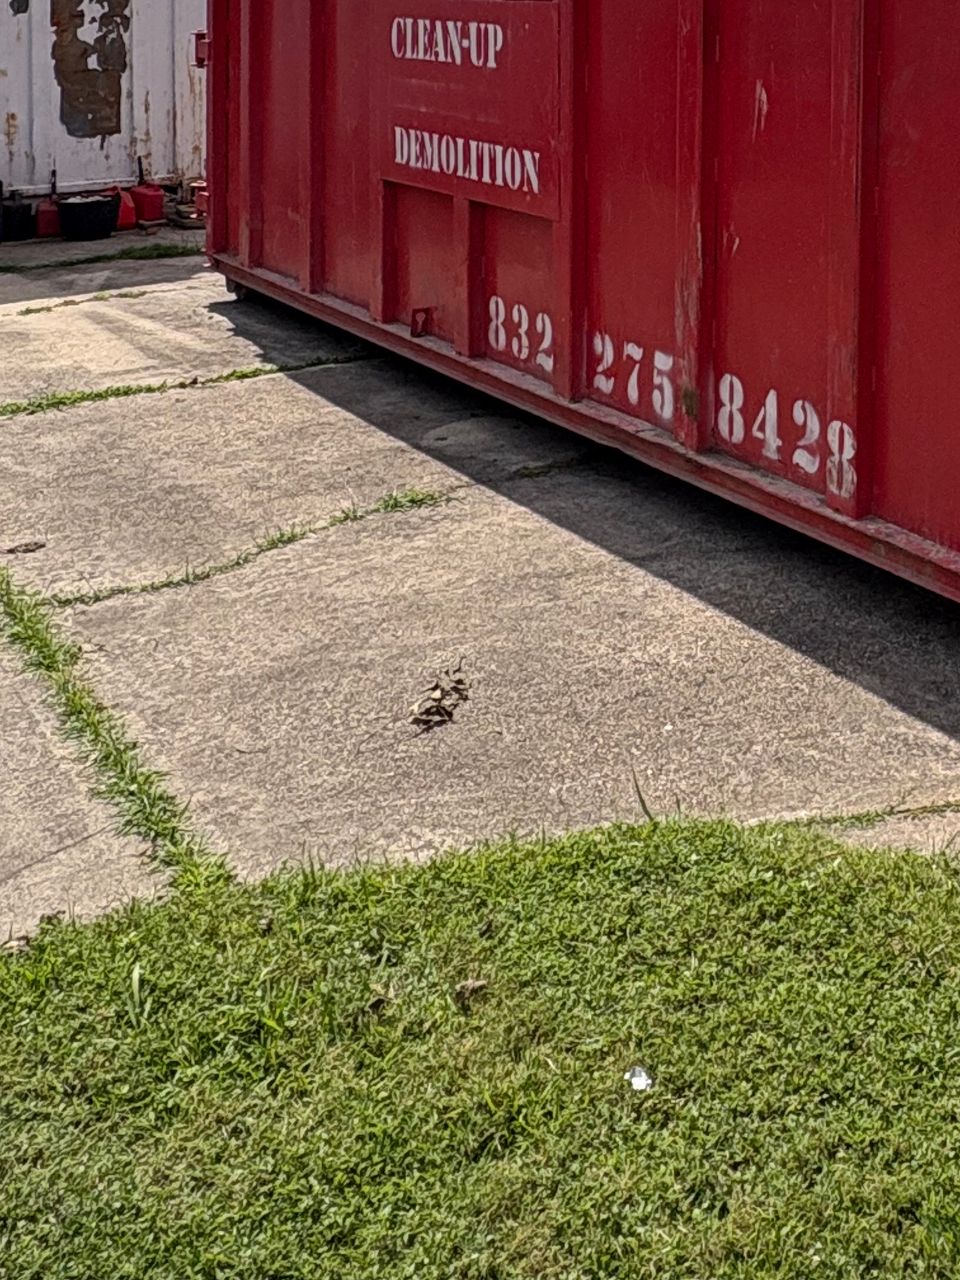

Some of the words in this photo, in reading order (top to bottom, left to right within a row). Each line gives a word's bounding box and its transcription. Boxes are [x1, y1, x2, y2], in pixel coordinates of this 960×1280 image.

[390, 17, 503, 69] CLEAN-UP
[394, 126, 540, 194] DEMOLITION
[488, 296, 554, 372] 832
[593, 333, 674, 420] 275
[717, 373, 857, 498] 8428
